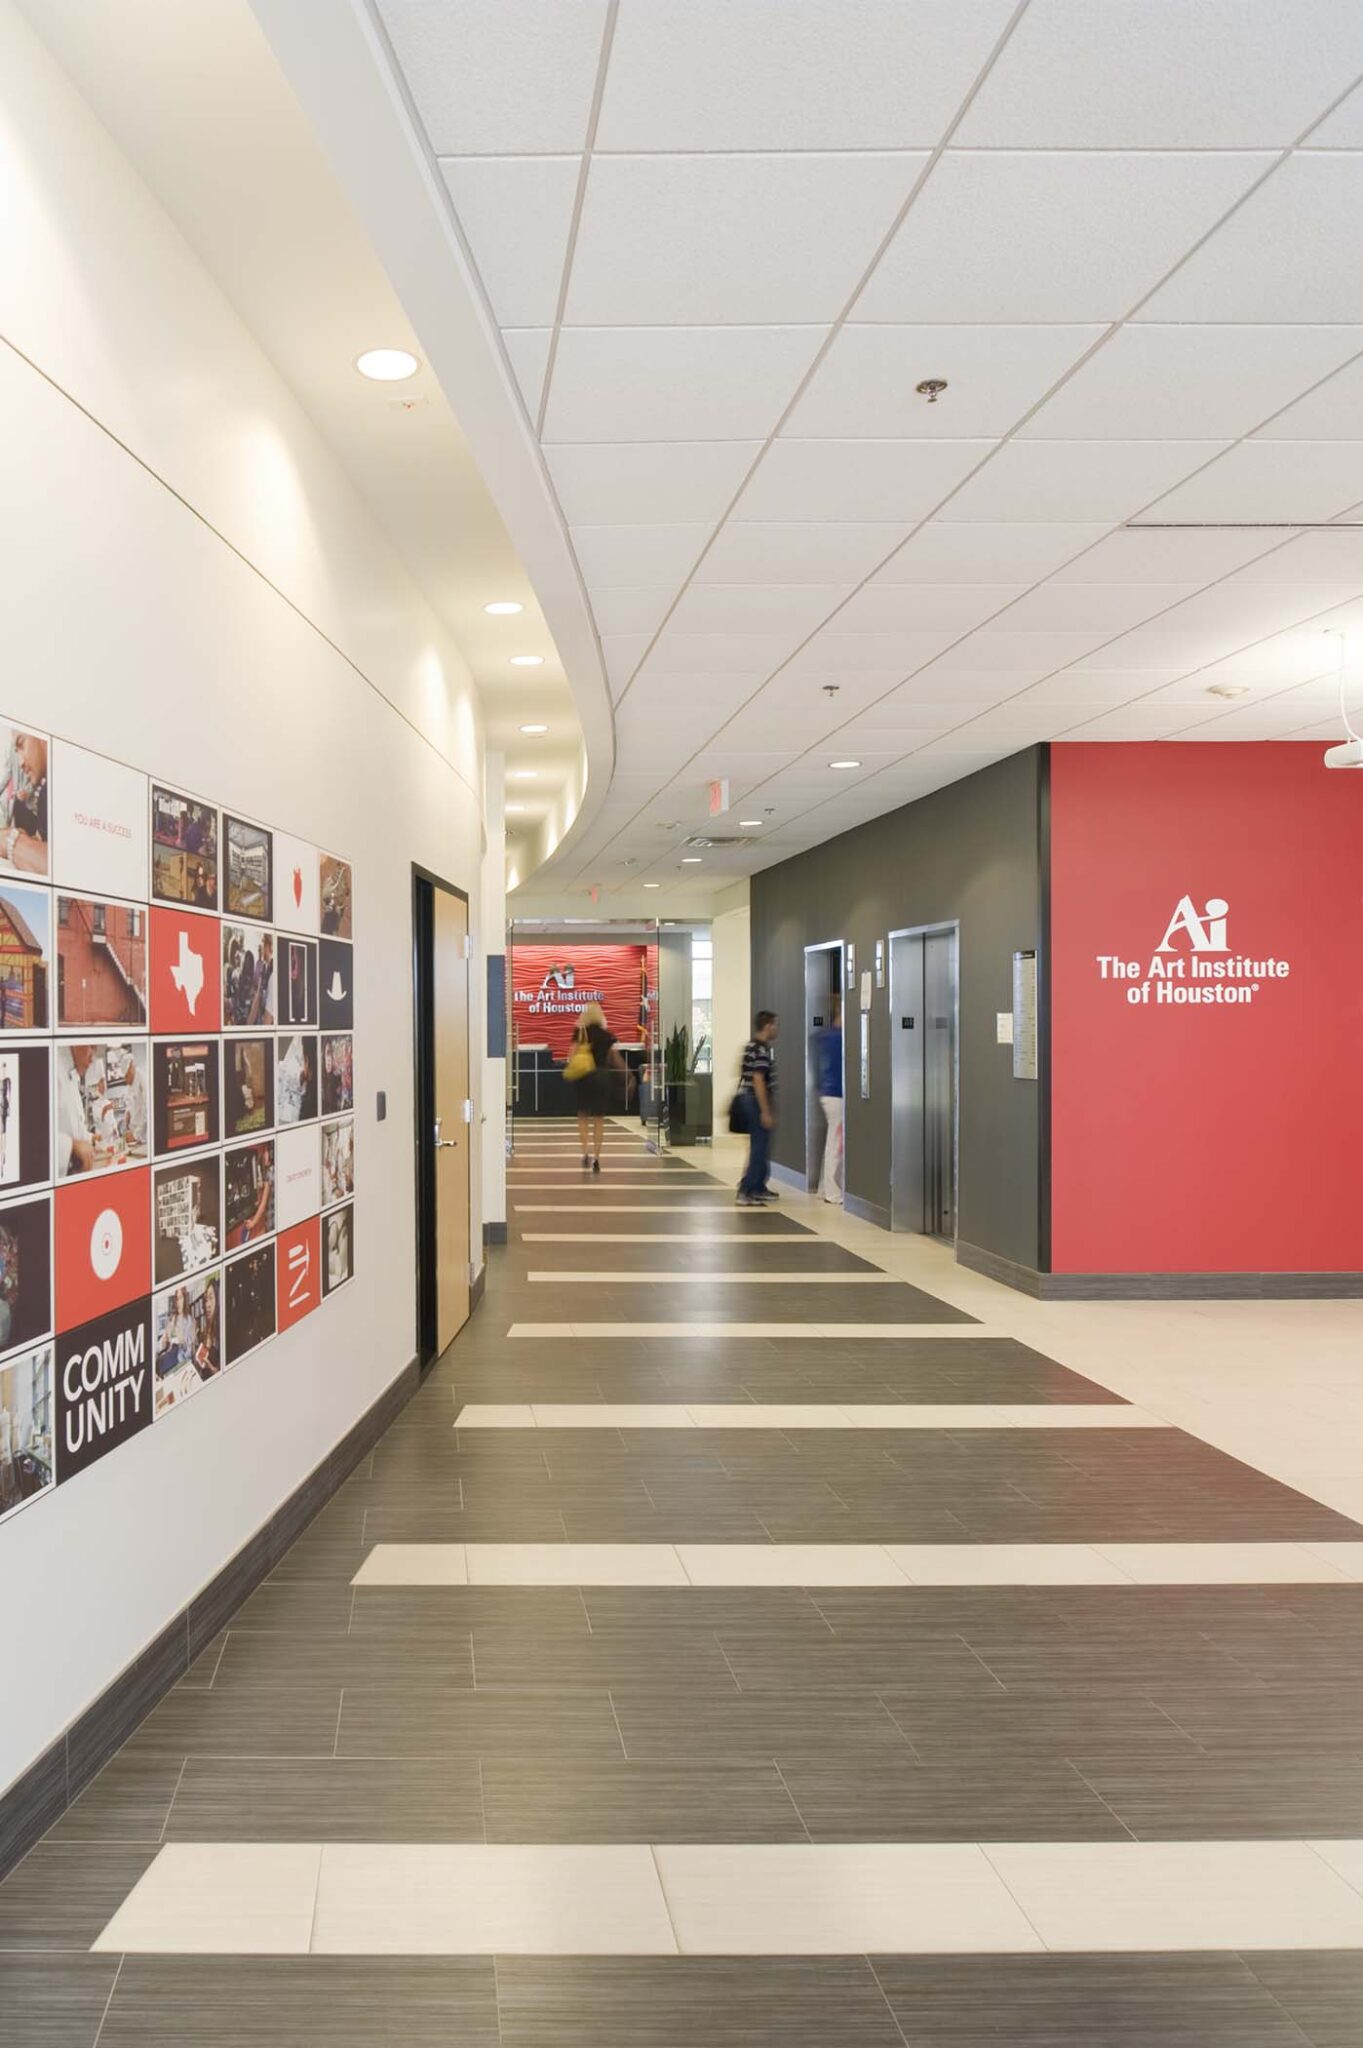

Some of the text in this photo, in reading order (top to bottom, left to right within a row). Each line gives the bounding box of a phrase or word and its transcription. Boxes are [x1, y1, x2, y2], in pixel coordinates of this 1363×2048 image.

[1096, 955, 1290, 979] The Art Institute
[537, 990, 555, 1001] Art
[557, 990, 604, 1001] Institute
[1127, 981, 1151, 1004] of
[528, 1002, 540, 1013] of
[63, 1322, 145, 1402] COMM
[65, 1368, 145, 1454] UNITY
